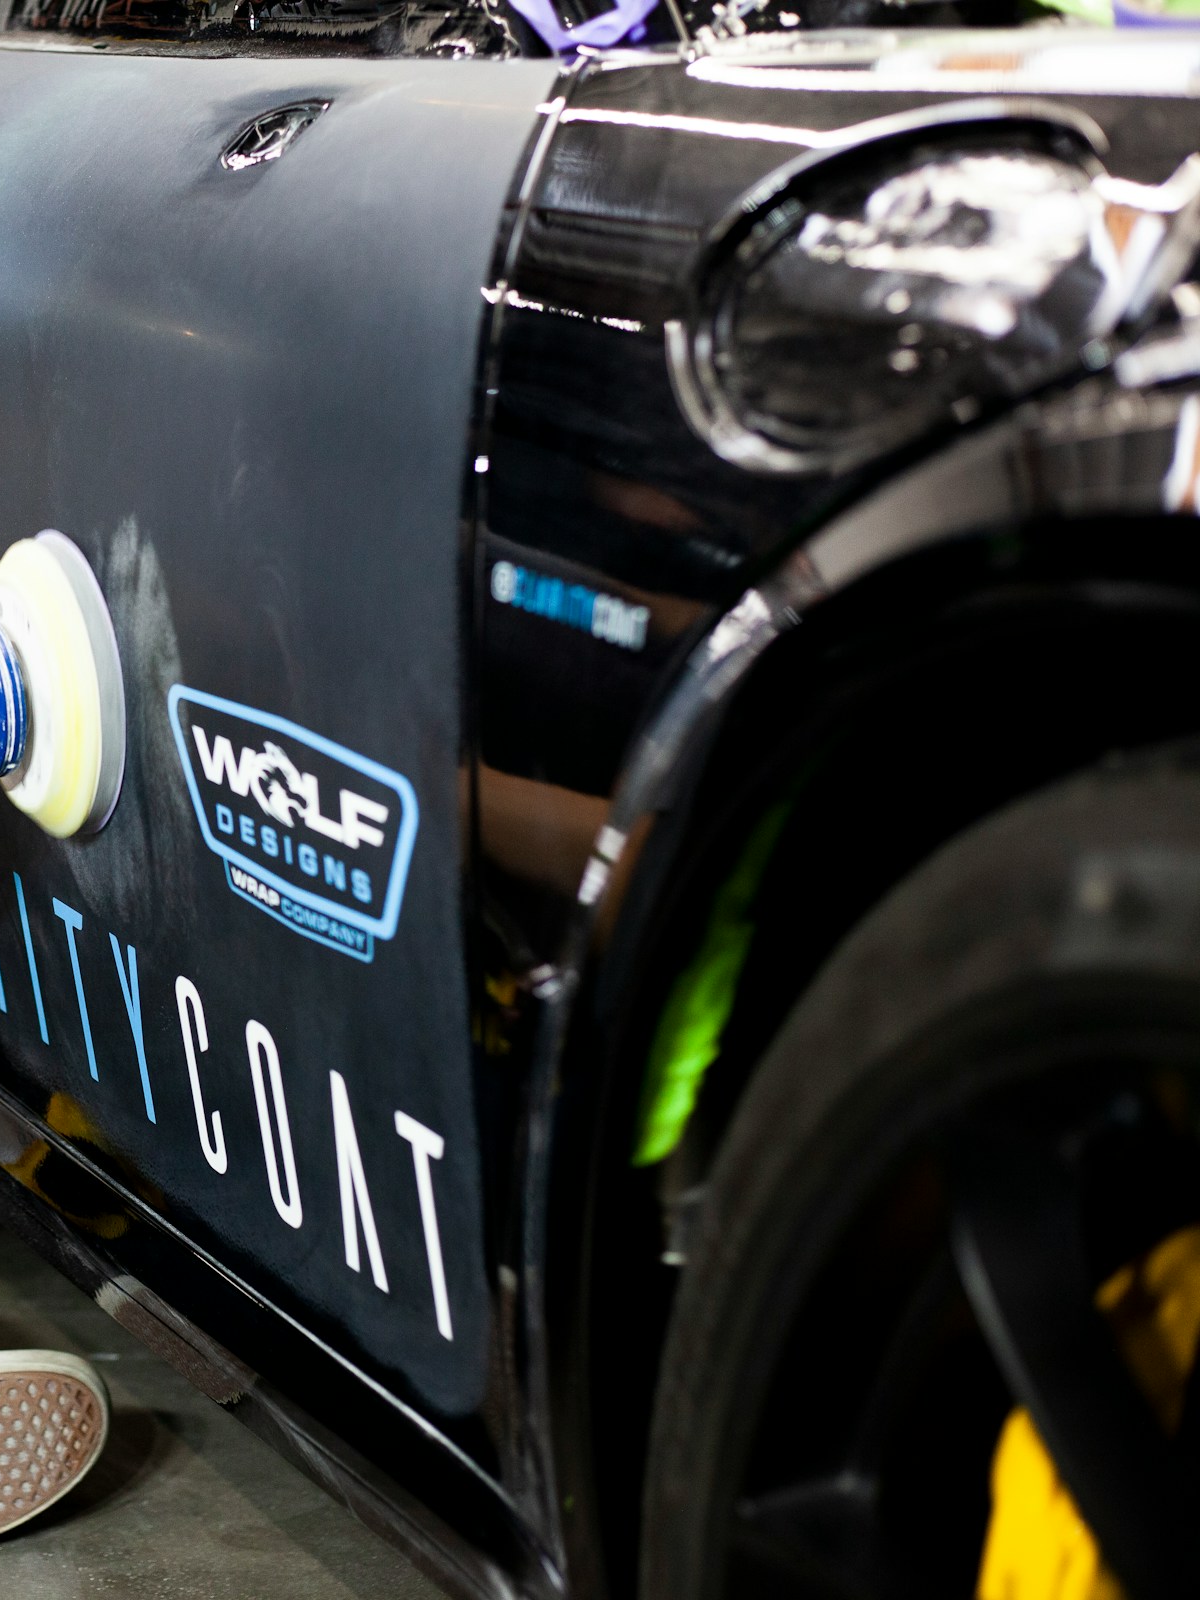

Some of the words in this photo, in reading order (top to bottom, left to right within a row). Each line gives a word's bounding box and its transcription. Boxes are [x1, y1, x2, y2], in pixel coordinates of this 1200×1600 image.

[191, 724, 389, 849] WOLF
[216, 803, 372, 903] DESIGNS
[231, 866, 280, 906] WRAP
[280, 898, 367, 949] COMPANY
